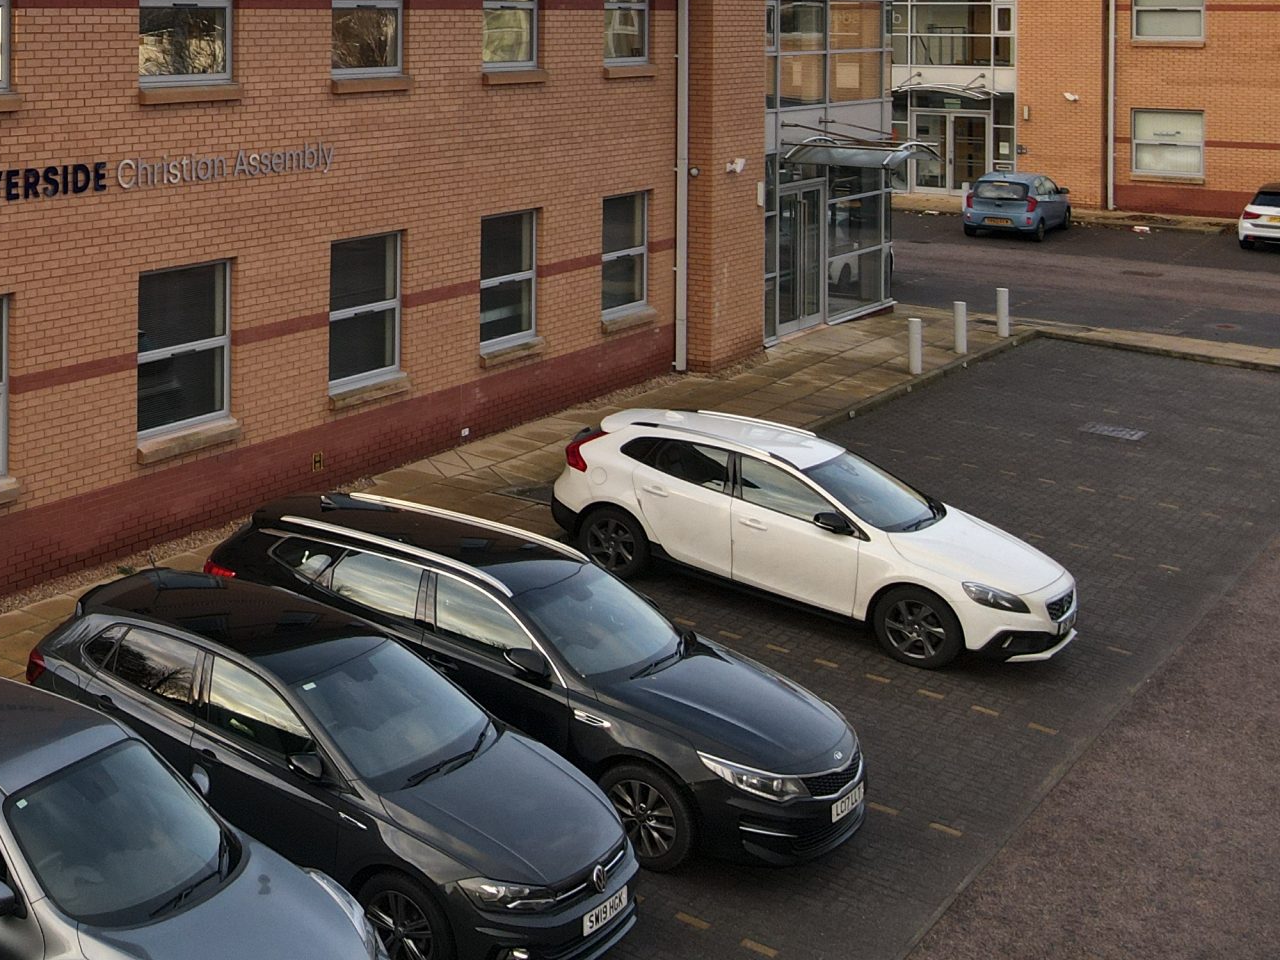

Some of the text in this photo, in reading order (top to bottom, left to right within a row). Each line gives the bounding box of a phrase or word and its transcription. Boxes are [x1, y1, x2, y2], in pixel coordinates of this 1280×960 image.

[117, 153, 227, 190] Christian
[233, 141, 335, 178] Assembly
[588, 891, 624, 929] SW19 HGK
